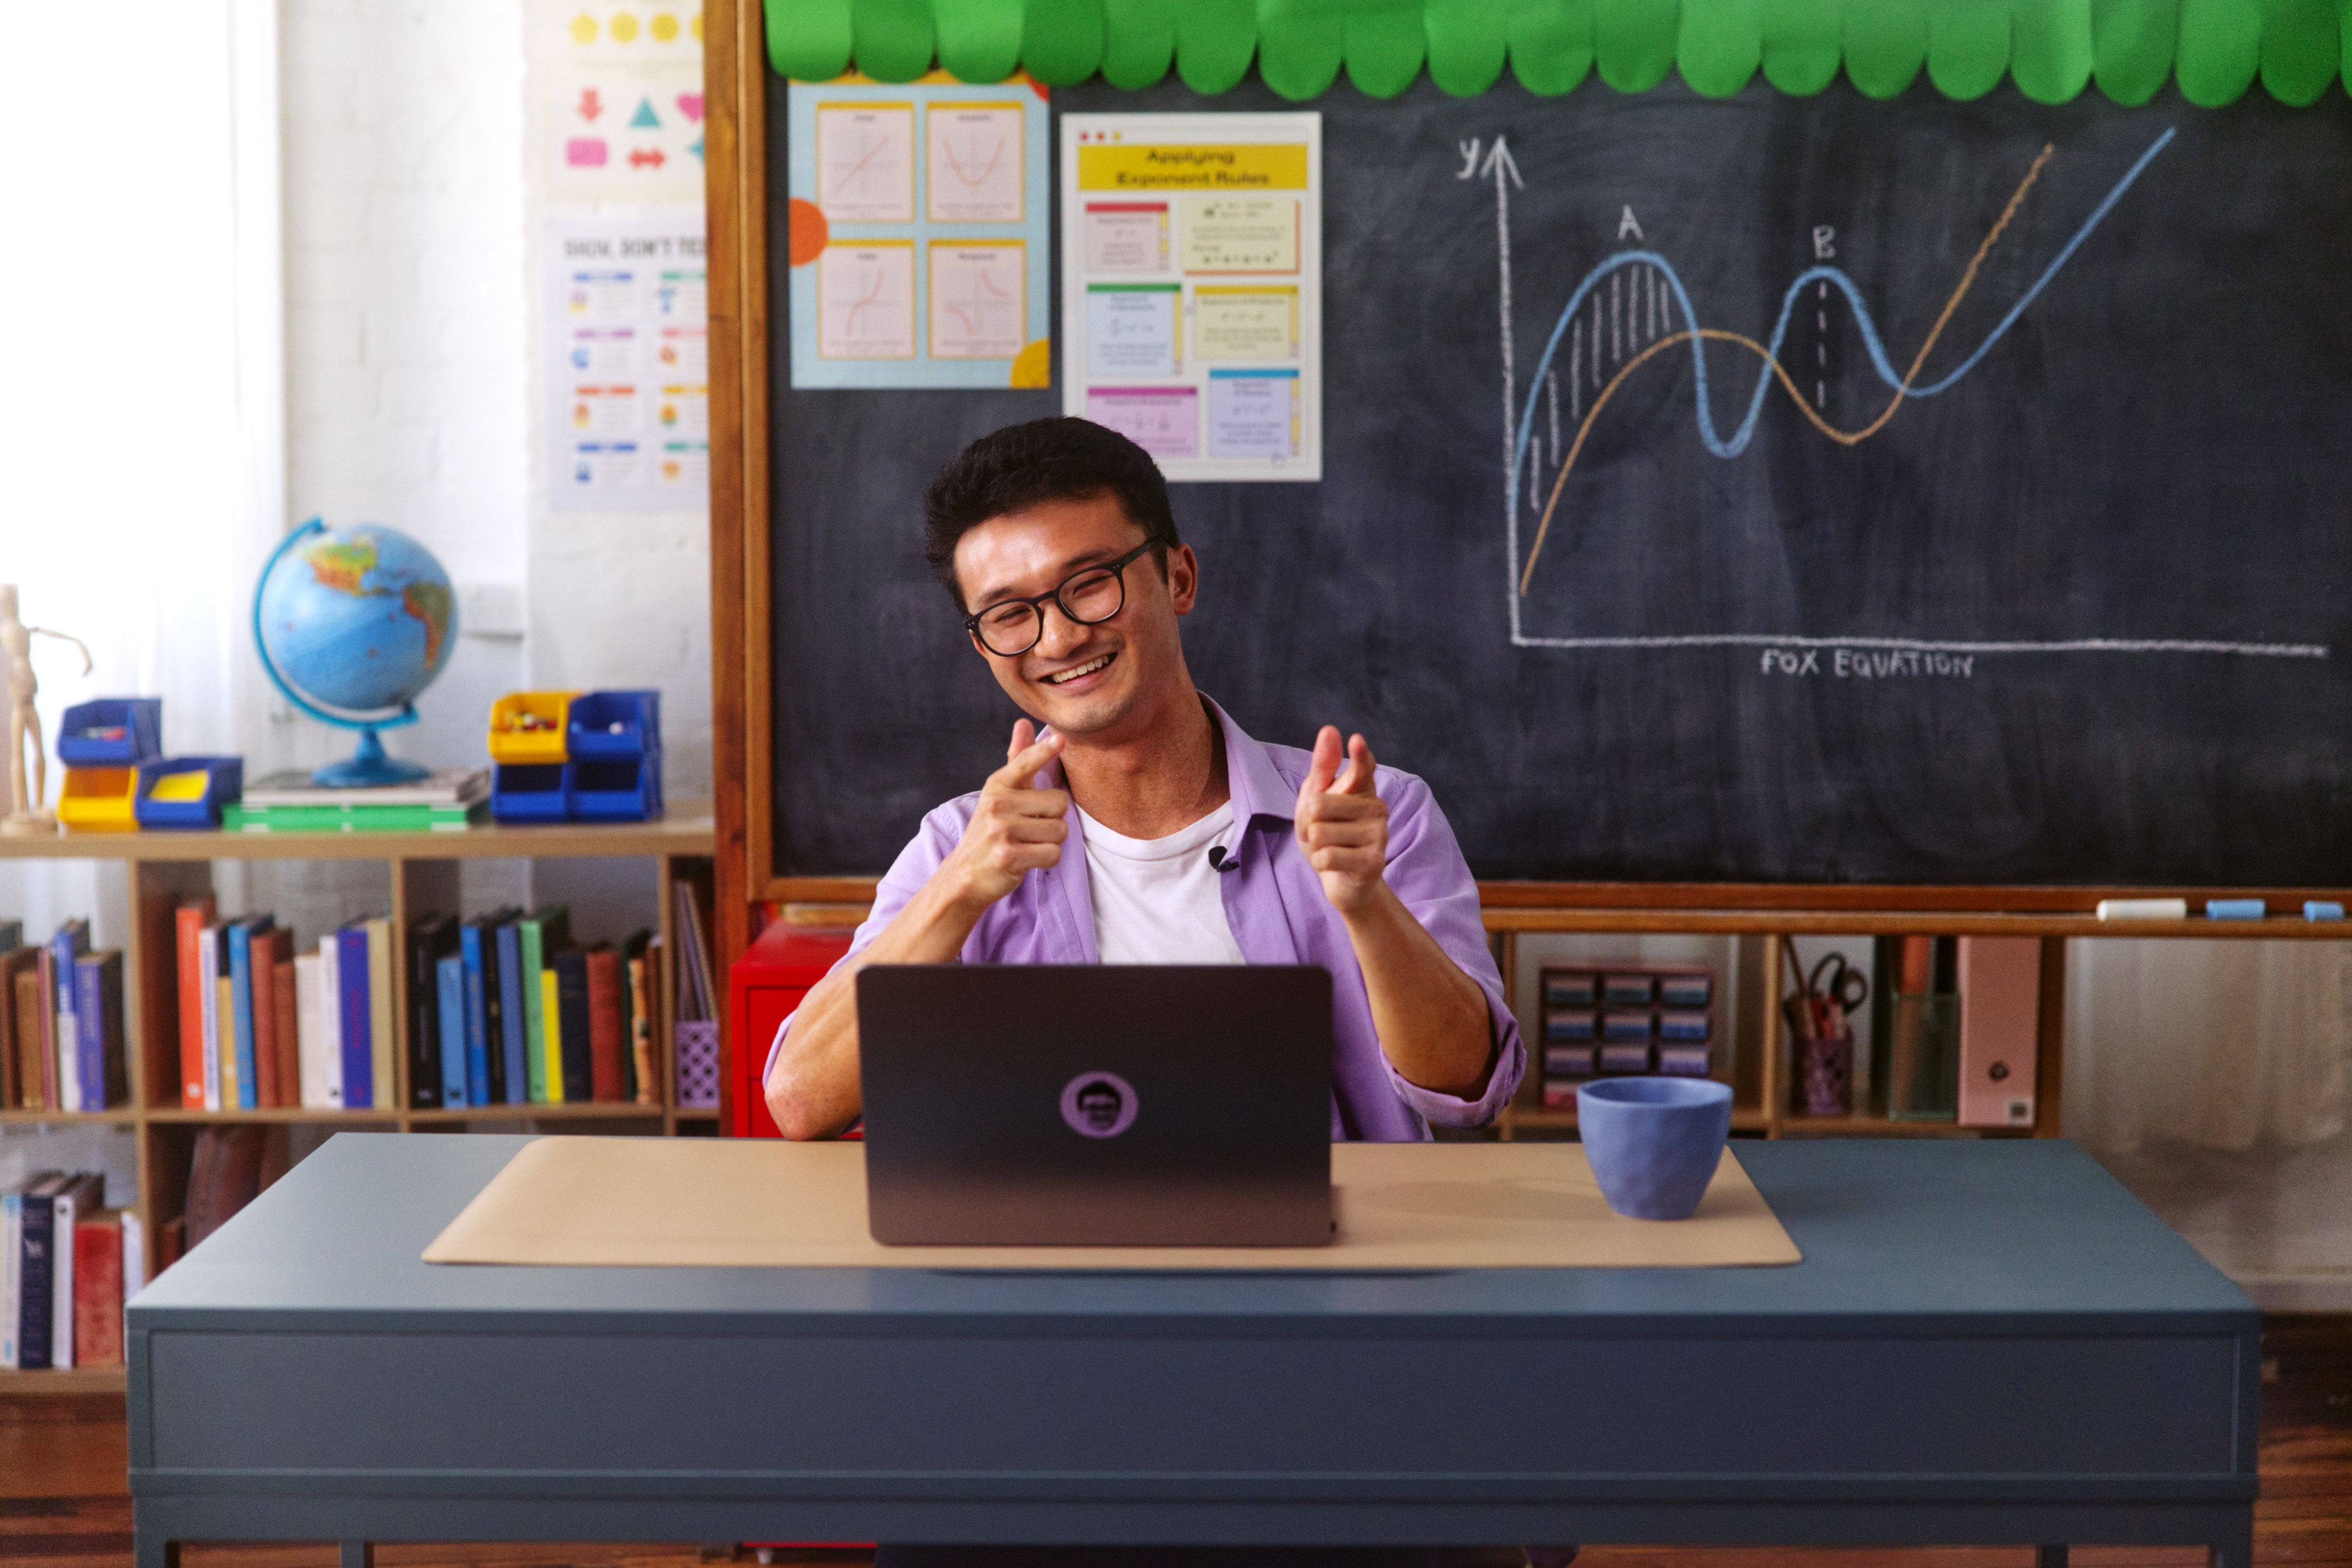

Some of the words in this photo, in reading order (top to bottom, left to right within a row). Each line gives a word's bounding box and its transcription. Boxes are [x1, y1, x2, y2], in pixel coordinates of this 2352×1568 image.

[1147, 149, 1235, 166] Applying
[1117, 172, 1210, 186] Exponent
[1215, 172, 1269, 185] Rules
[1618, 204, 1644, 240] A
[1813, 225, 1836, 260] B
[1761, 648, 1820, 677] FOX
[1834, 648, 1973, 678] EQUATION
